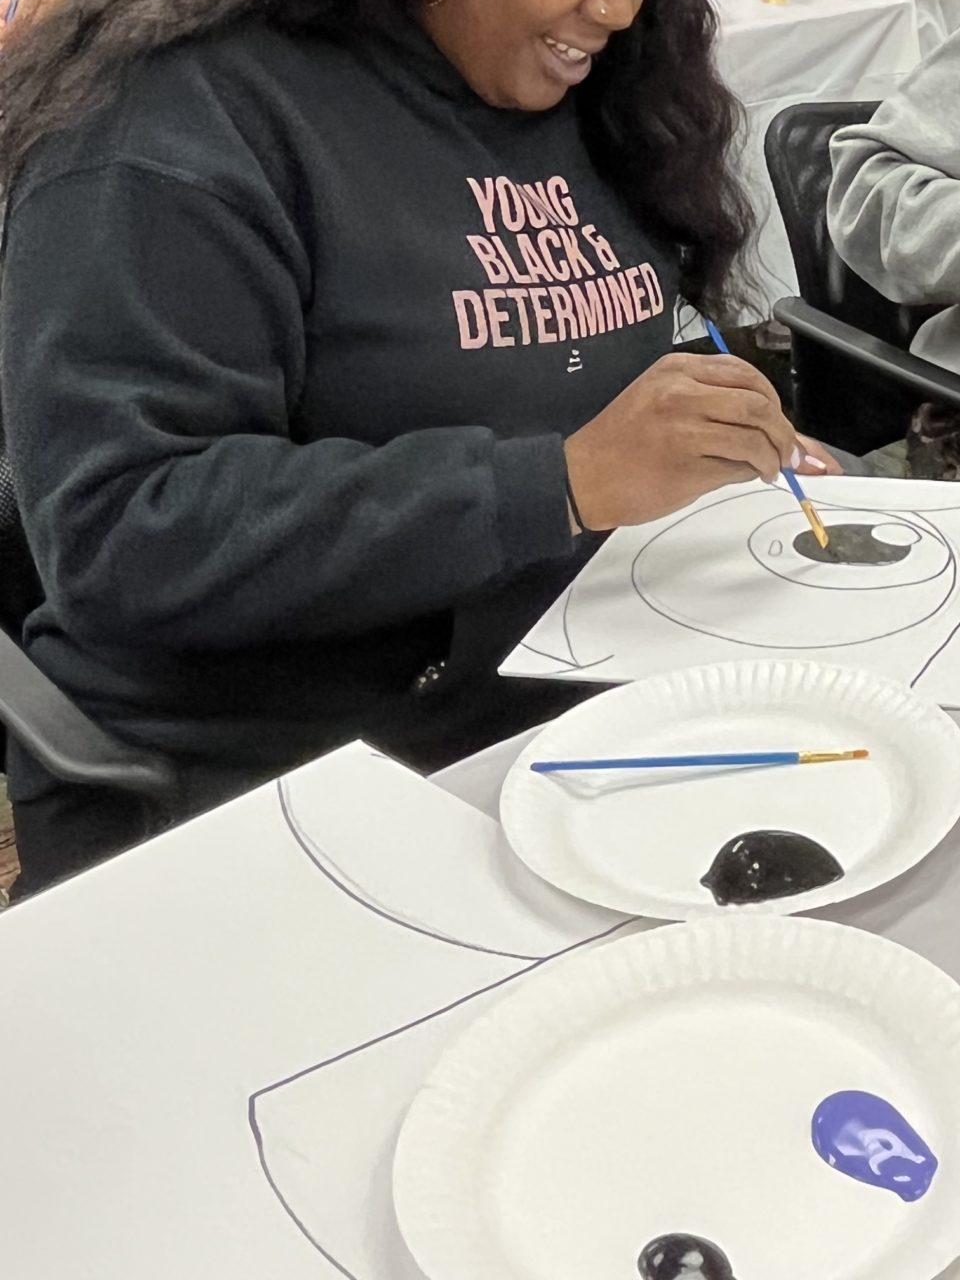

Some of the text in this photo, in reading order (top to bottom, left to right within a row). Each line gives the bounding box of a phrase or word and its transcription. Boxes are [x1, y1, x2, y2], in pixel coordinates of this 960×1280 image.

[466, 176, 579, 233] YOUNG
[466, 224, 621, 284] BLACK &
[452, 262, 664, 349] DETERMINED
